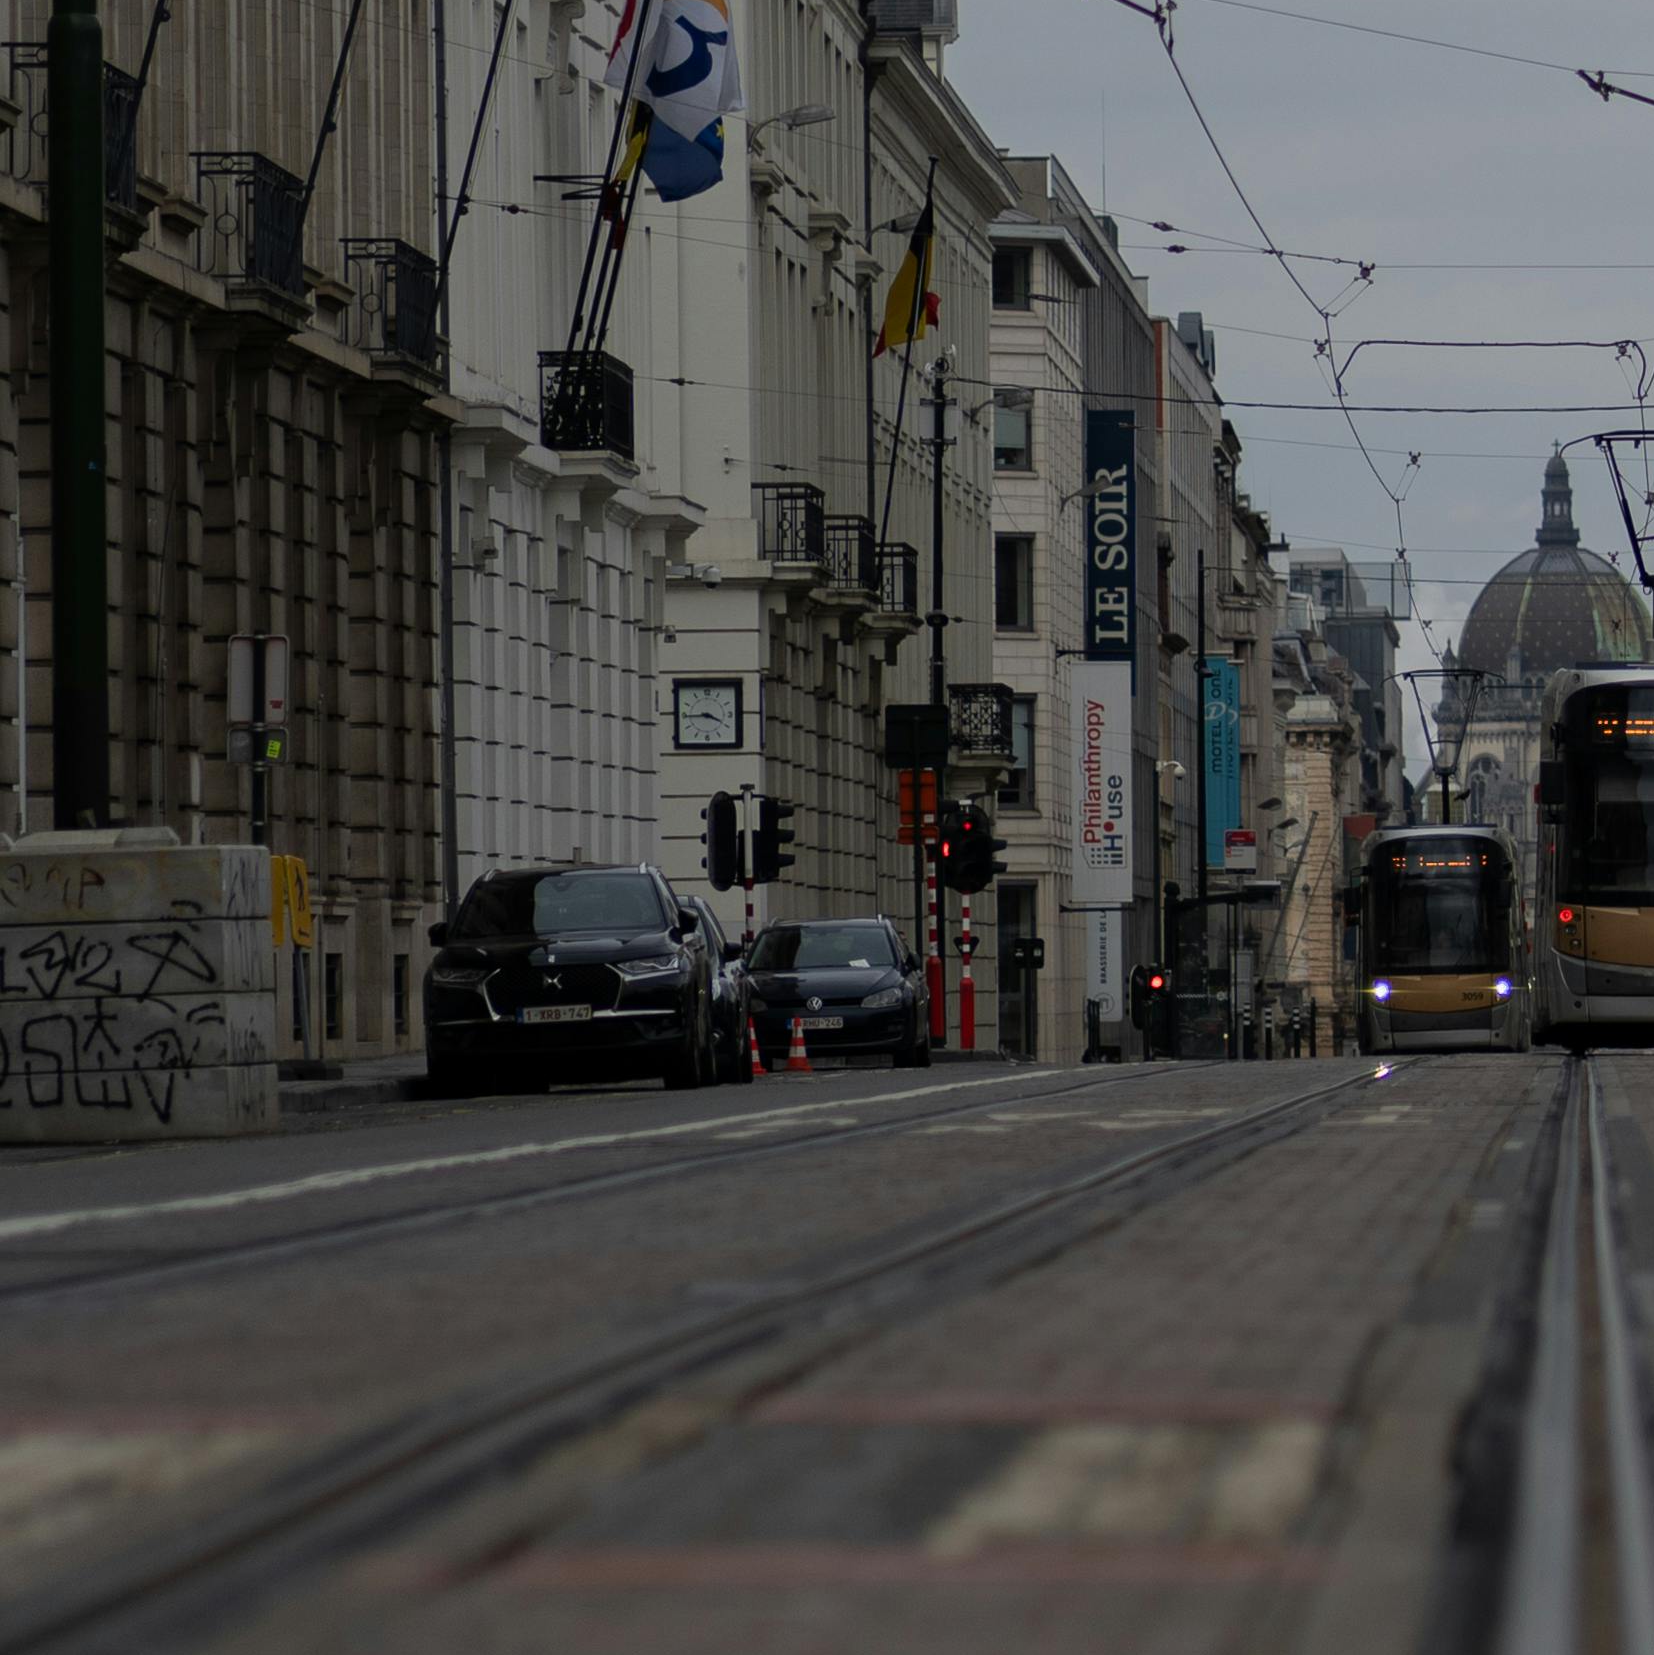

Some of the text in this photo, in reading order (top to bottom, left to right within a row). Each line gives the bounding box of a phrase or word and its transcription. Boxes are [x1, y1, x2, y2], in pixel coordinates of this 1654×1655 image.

[1094, 464, 1128, 644] LE SOIR
[1083, 700, 1104, 844] Philanthropy
